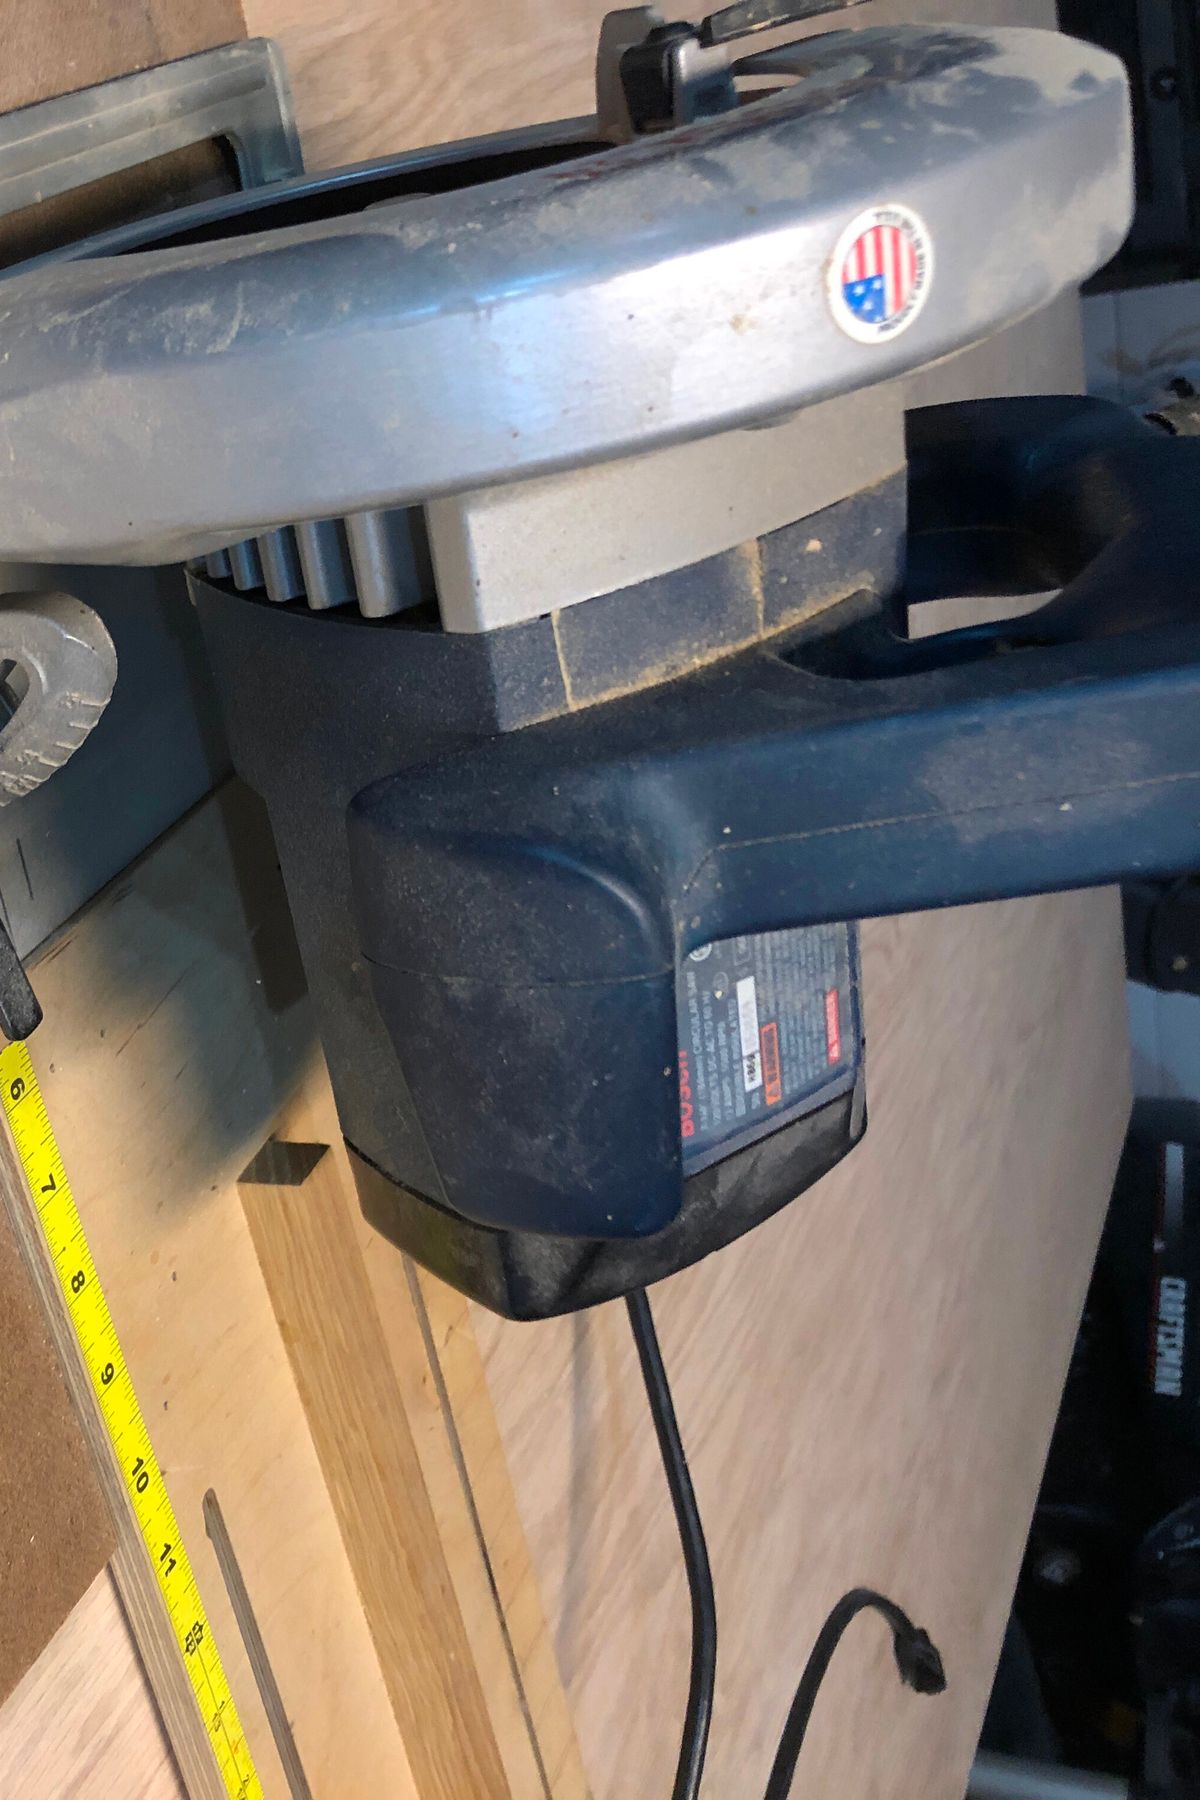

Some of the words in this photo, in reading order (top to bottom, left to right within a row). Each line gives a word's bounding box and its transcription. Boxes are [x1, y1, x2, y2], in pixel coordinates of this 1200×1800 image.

[10, 1077, 26, 1101] 6
[40, 1174, 56, 1194] 7
[71, 1270, 86, 1294] 8
[101, 1362, 115, 1386] 9
[131, 1457, 150, 1494] 10
[159, 1543, 177, 1578] 11
